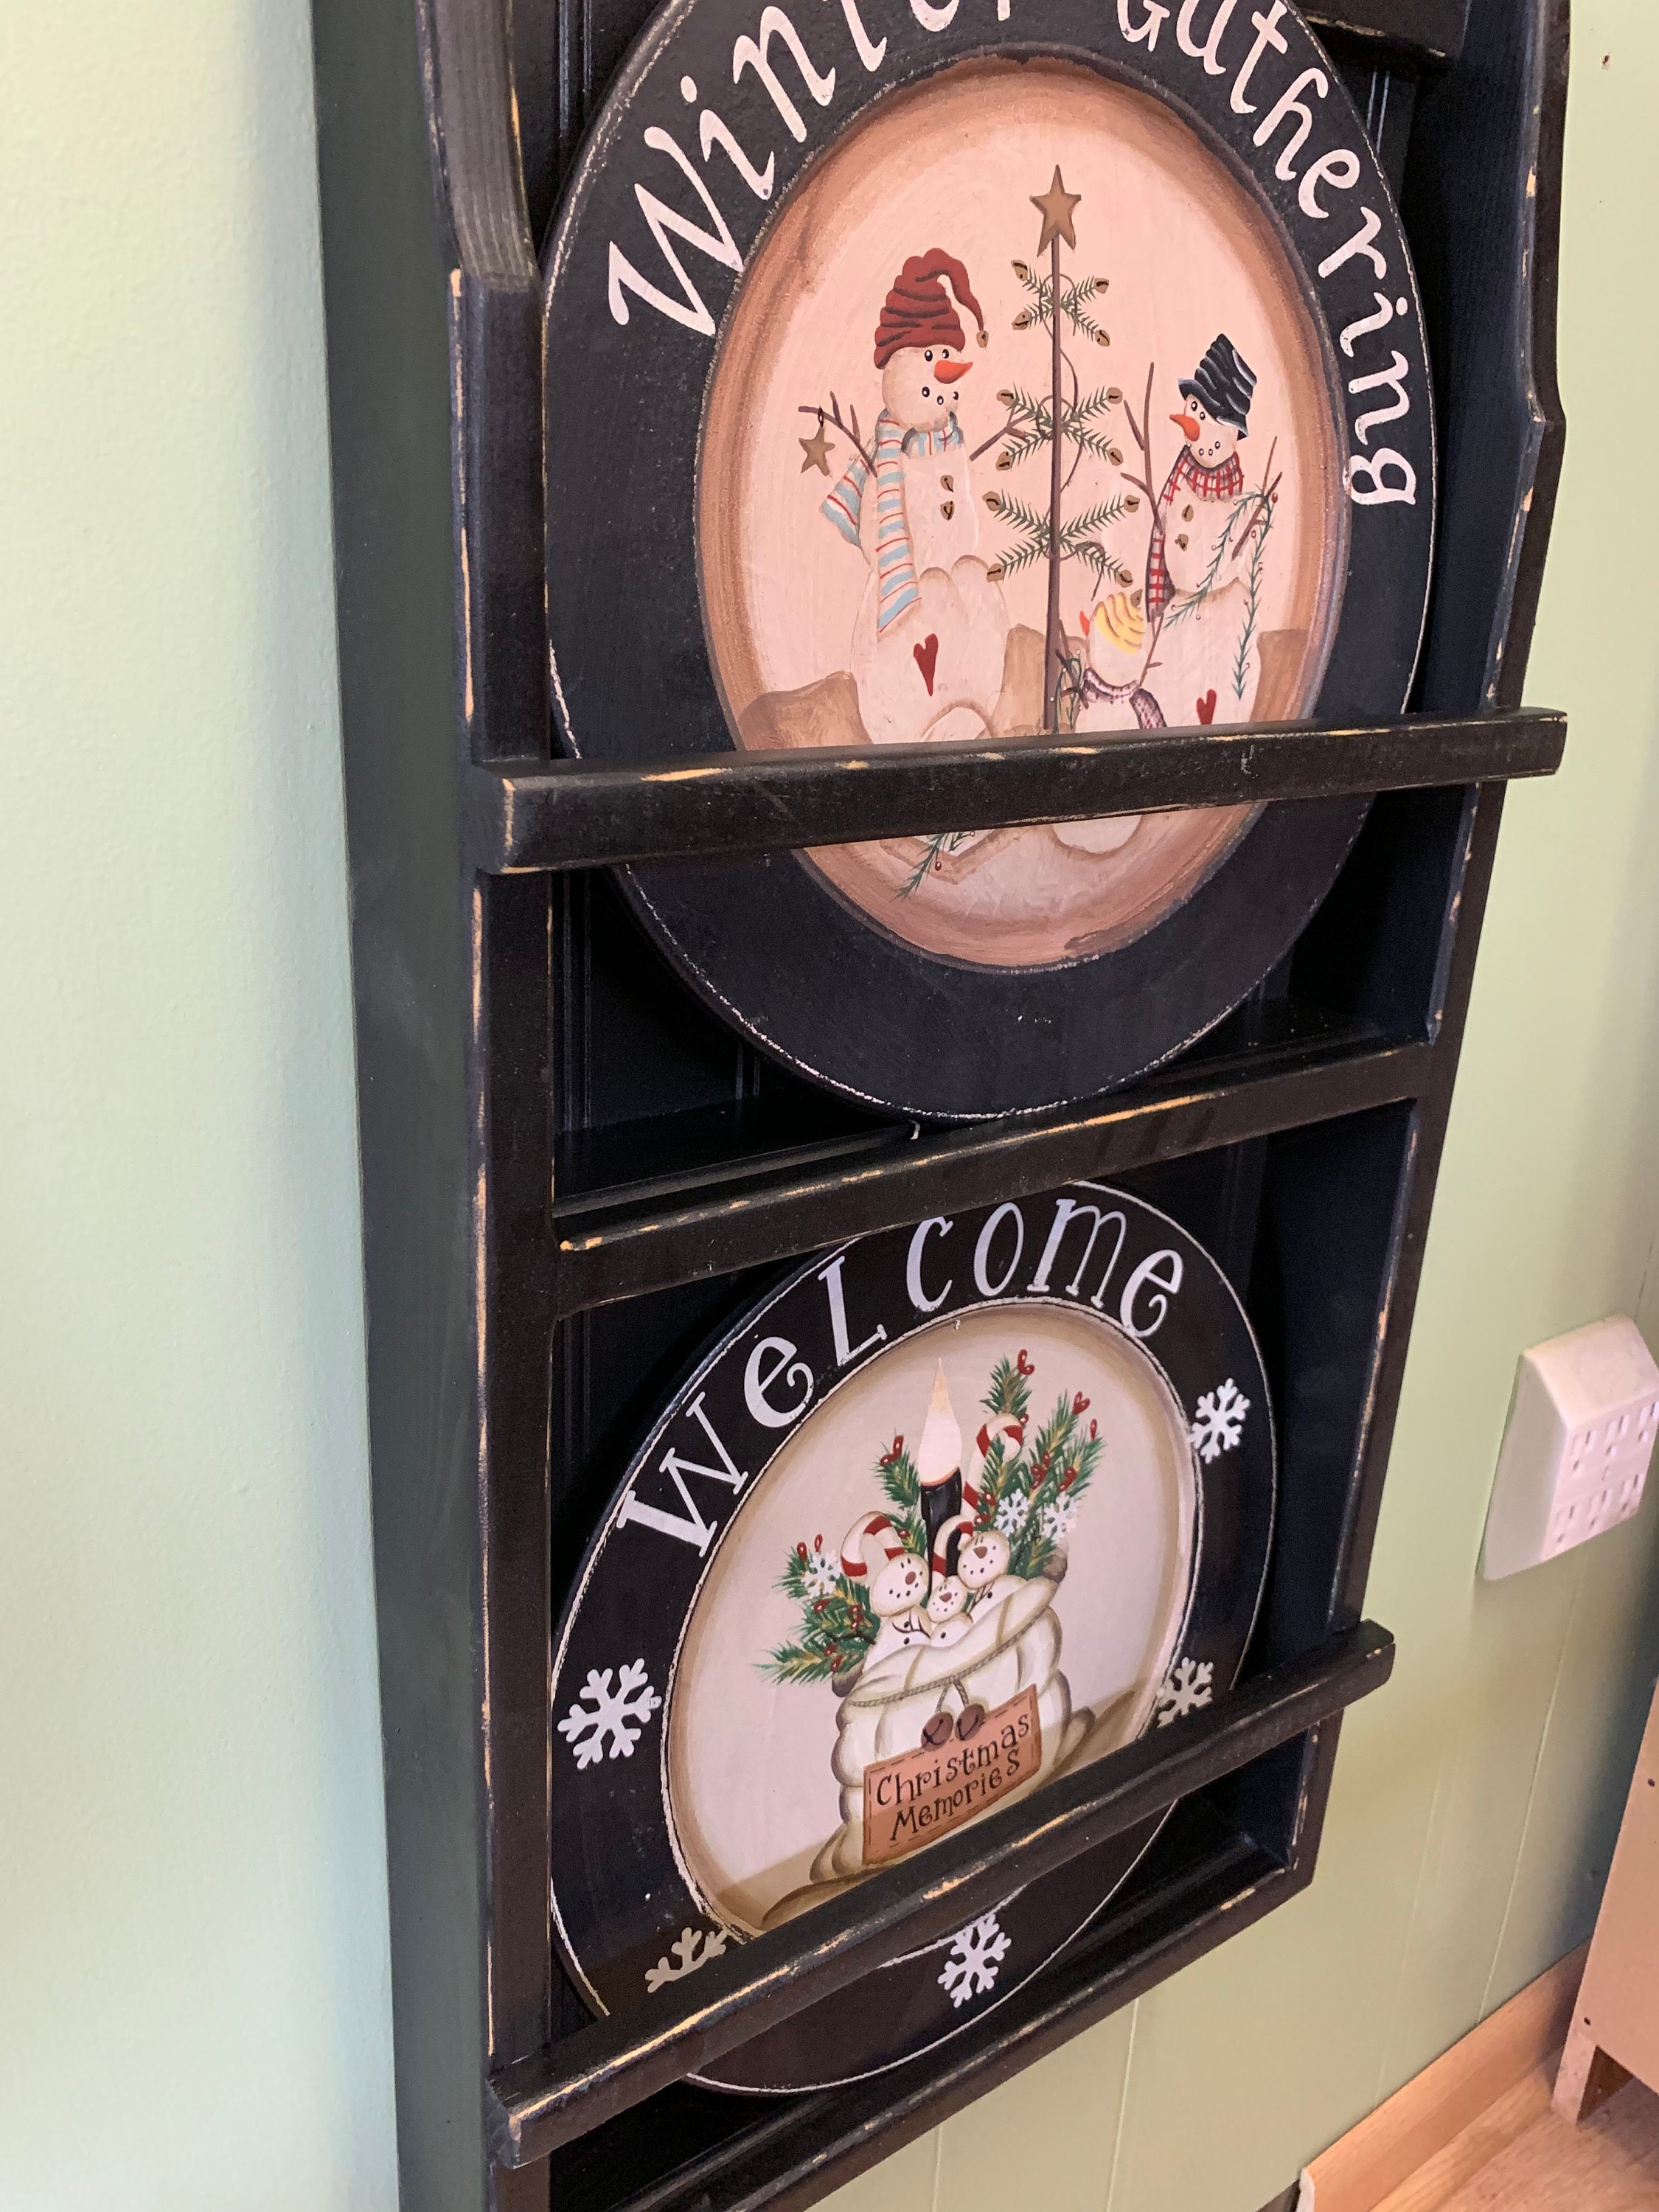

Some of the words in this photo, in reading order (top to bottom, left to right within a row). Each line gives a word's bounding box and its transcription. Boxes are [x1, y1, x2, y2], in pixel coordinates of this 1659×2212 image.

[606, 0, 1011, 336] Wint
[876, 1712, 1030, 1806] Christmas
[888, 1748, 1021, 1841] Memories
